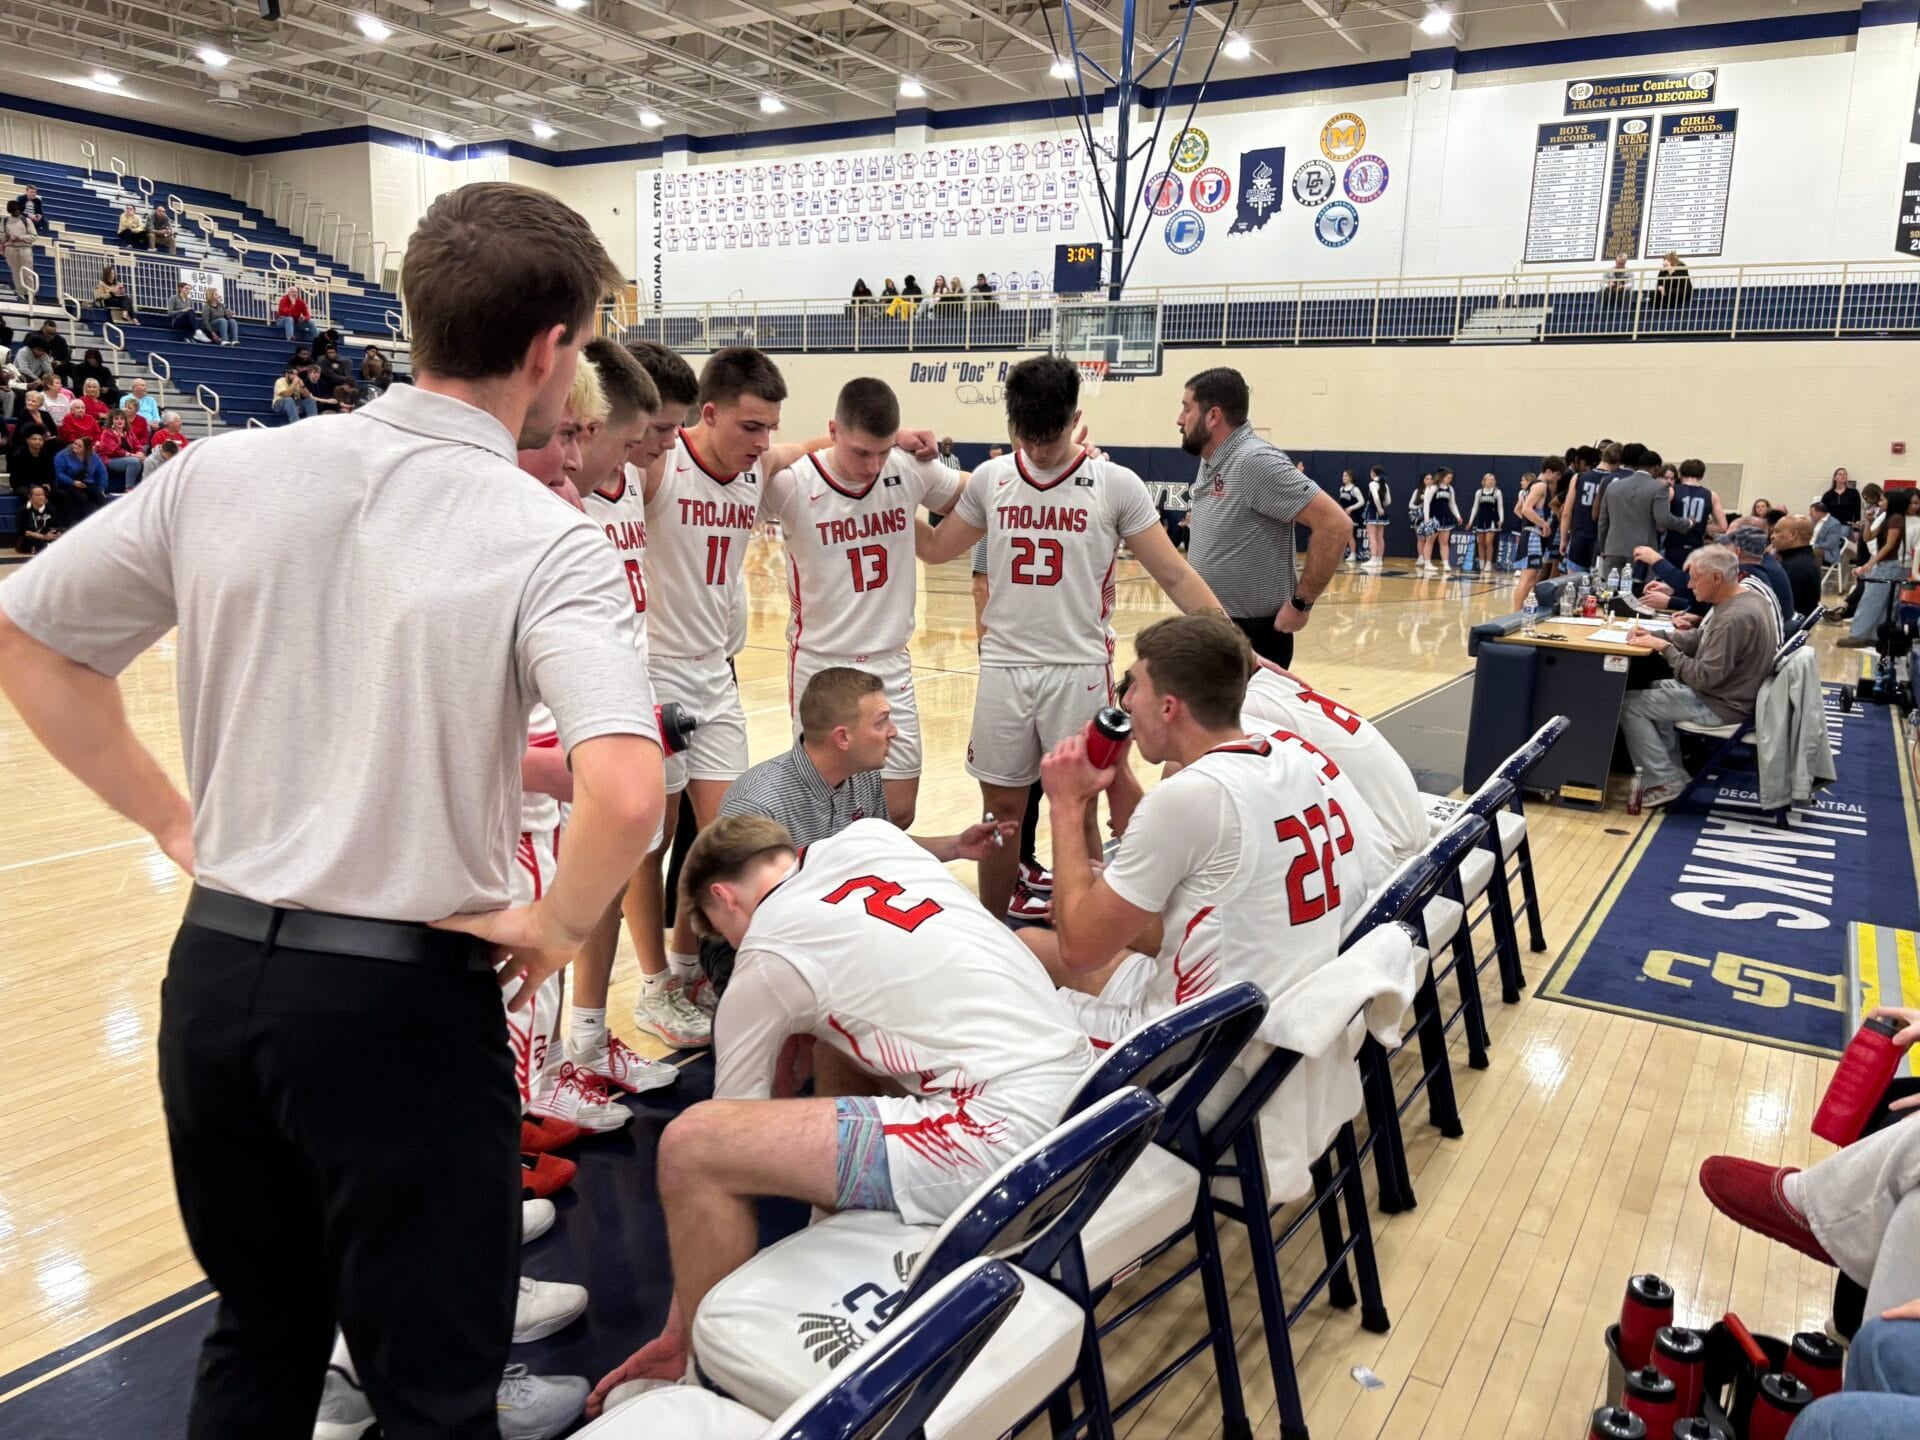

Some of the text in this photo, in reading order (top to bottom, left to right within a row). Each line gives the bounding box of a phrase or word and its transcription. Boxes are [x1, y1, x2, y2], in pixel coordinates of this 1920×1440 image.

[1593, 82, 1640, 96] Decatur
[1642, 77, 1688, 91] Central
[1571, 98, 1608, 110] TRACK
[1620, 94, 1653, 106] FIELD
[1655, 89, 1709, 103] RECORDS
[1559, 125, 1588, 136] BOYS
[1672, 123, 1723, 134] RECORDS
[1680, 115, 1716, 126] GIRLS
[1330, 125, 1357, 149] M
[1549, 133, 1597, 143] RECORDS
[1618, 133, 1649, 145] EVENT
[654, 172, 662, 314] INDIANA ALL STARS
[1174, 220, 1196, 243] F
[1067, 247, 1095, 262] 3:04
[910, 361, 947, 383] David
[678, 498, 756, 530] TROJANS
[997, 505, 1088, 533] TROJANS
[1682, 495, 1705, 523] 10
[816, 507, 907, 546] TROJANS
[706, 535, 731, 586] 11
[846, 543, 888, 593] 13
[1010, 537, 1064, 587] 23
[1719, 787, 1867, 814] DECA NTRAL
[1274, 803, 1341, 927] 22
[820, 875, 945, 934] 2
